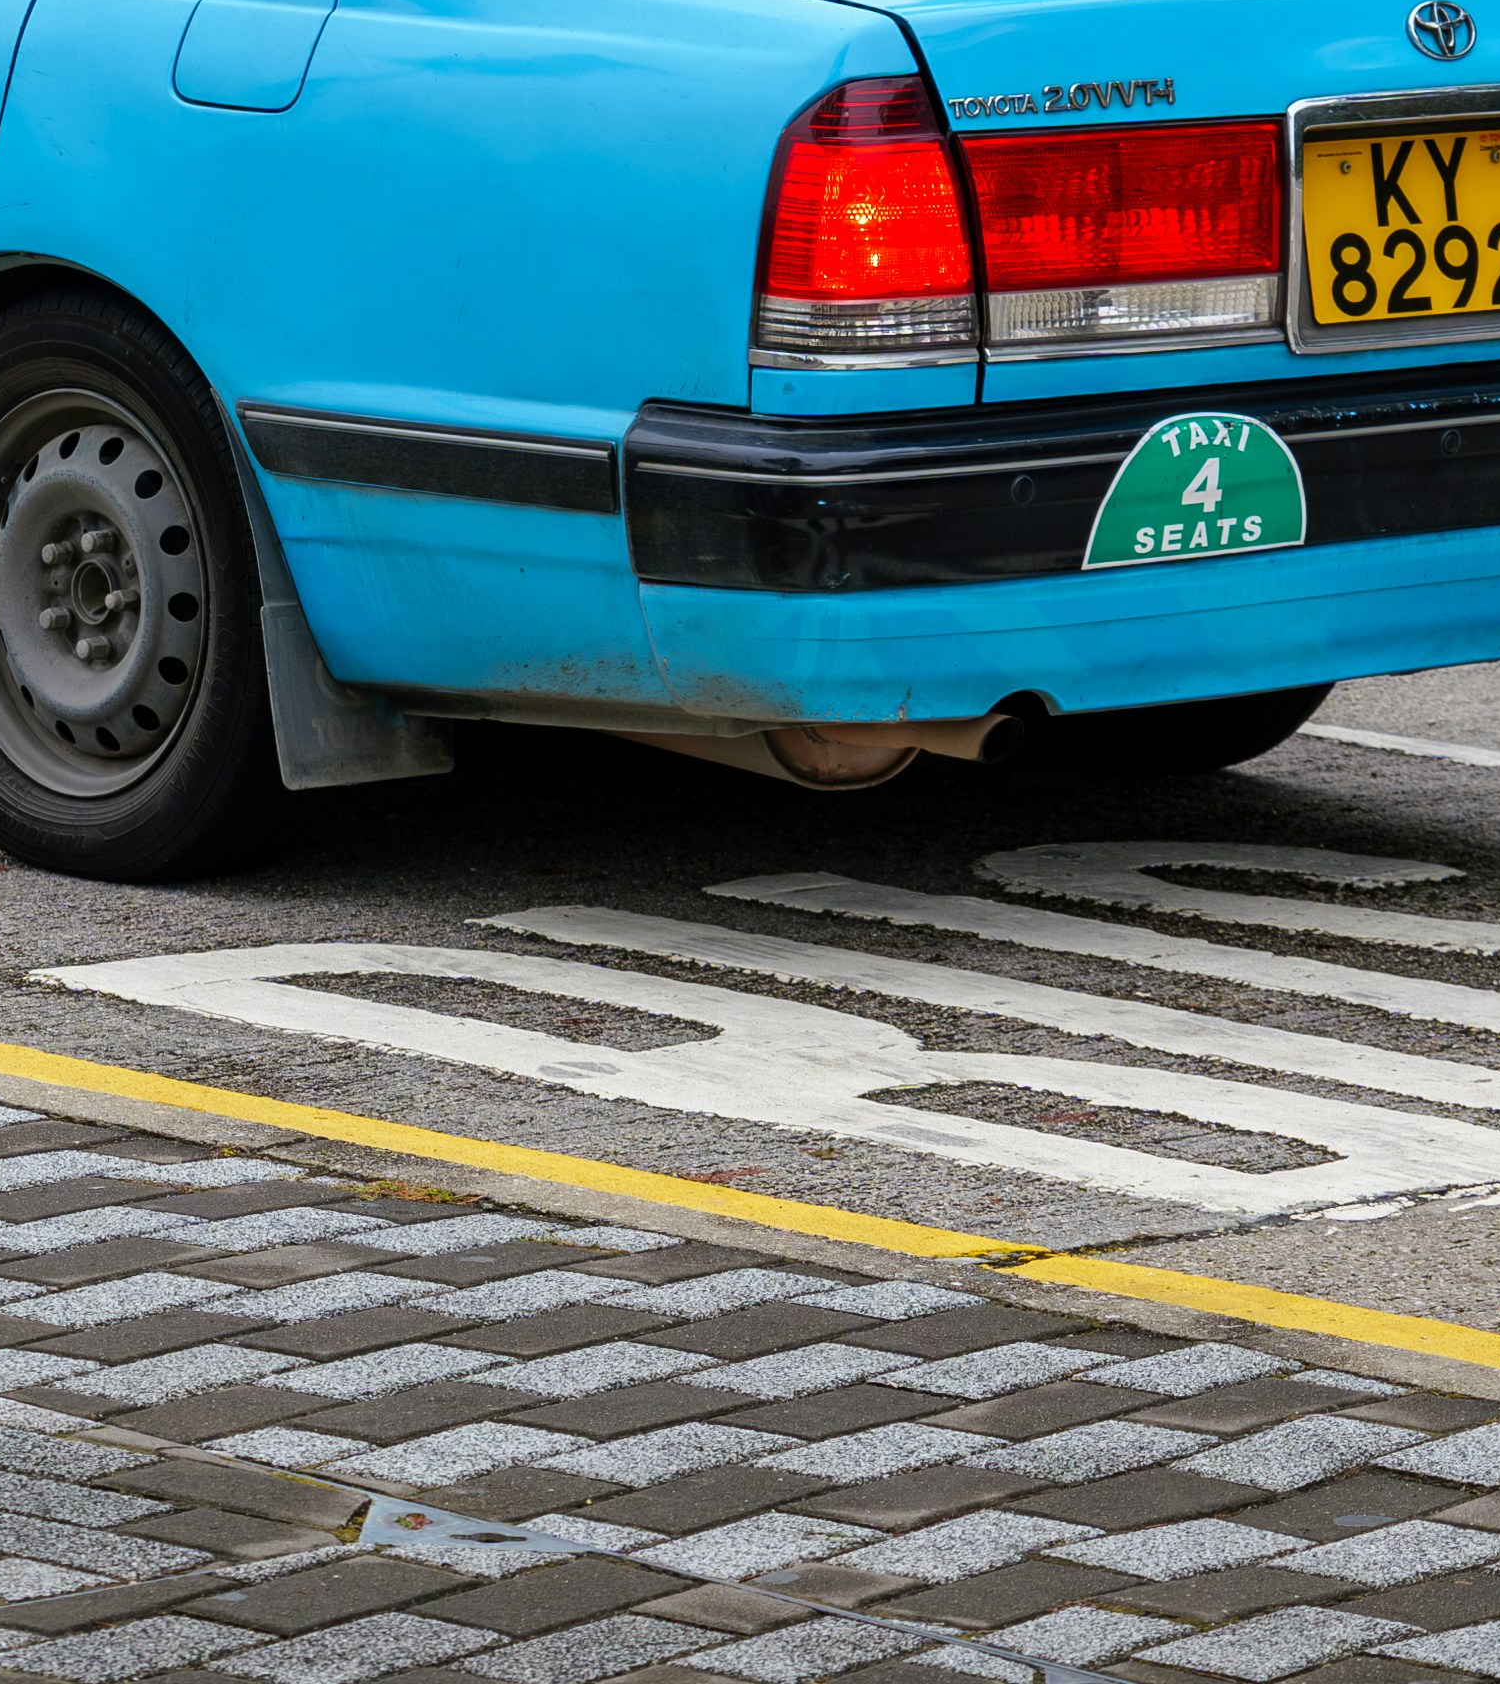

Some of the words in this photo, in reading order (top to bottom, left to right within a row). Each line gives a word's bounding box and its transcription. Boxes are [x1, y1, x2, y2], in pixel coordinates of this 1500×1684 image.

[948, 93, 1038, 118] TOYOTA
[1371, 137, 1468, 227] KY
[1162, 420, 1250, 457] TAXI
[1181, 457, 1222, 512] 4
[1134, 516, 1262, 554] SEATS
